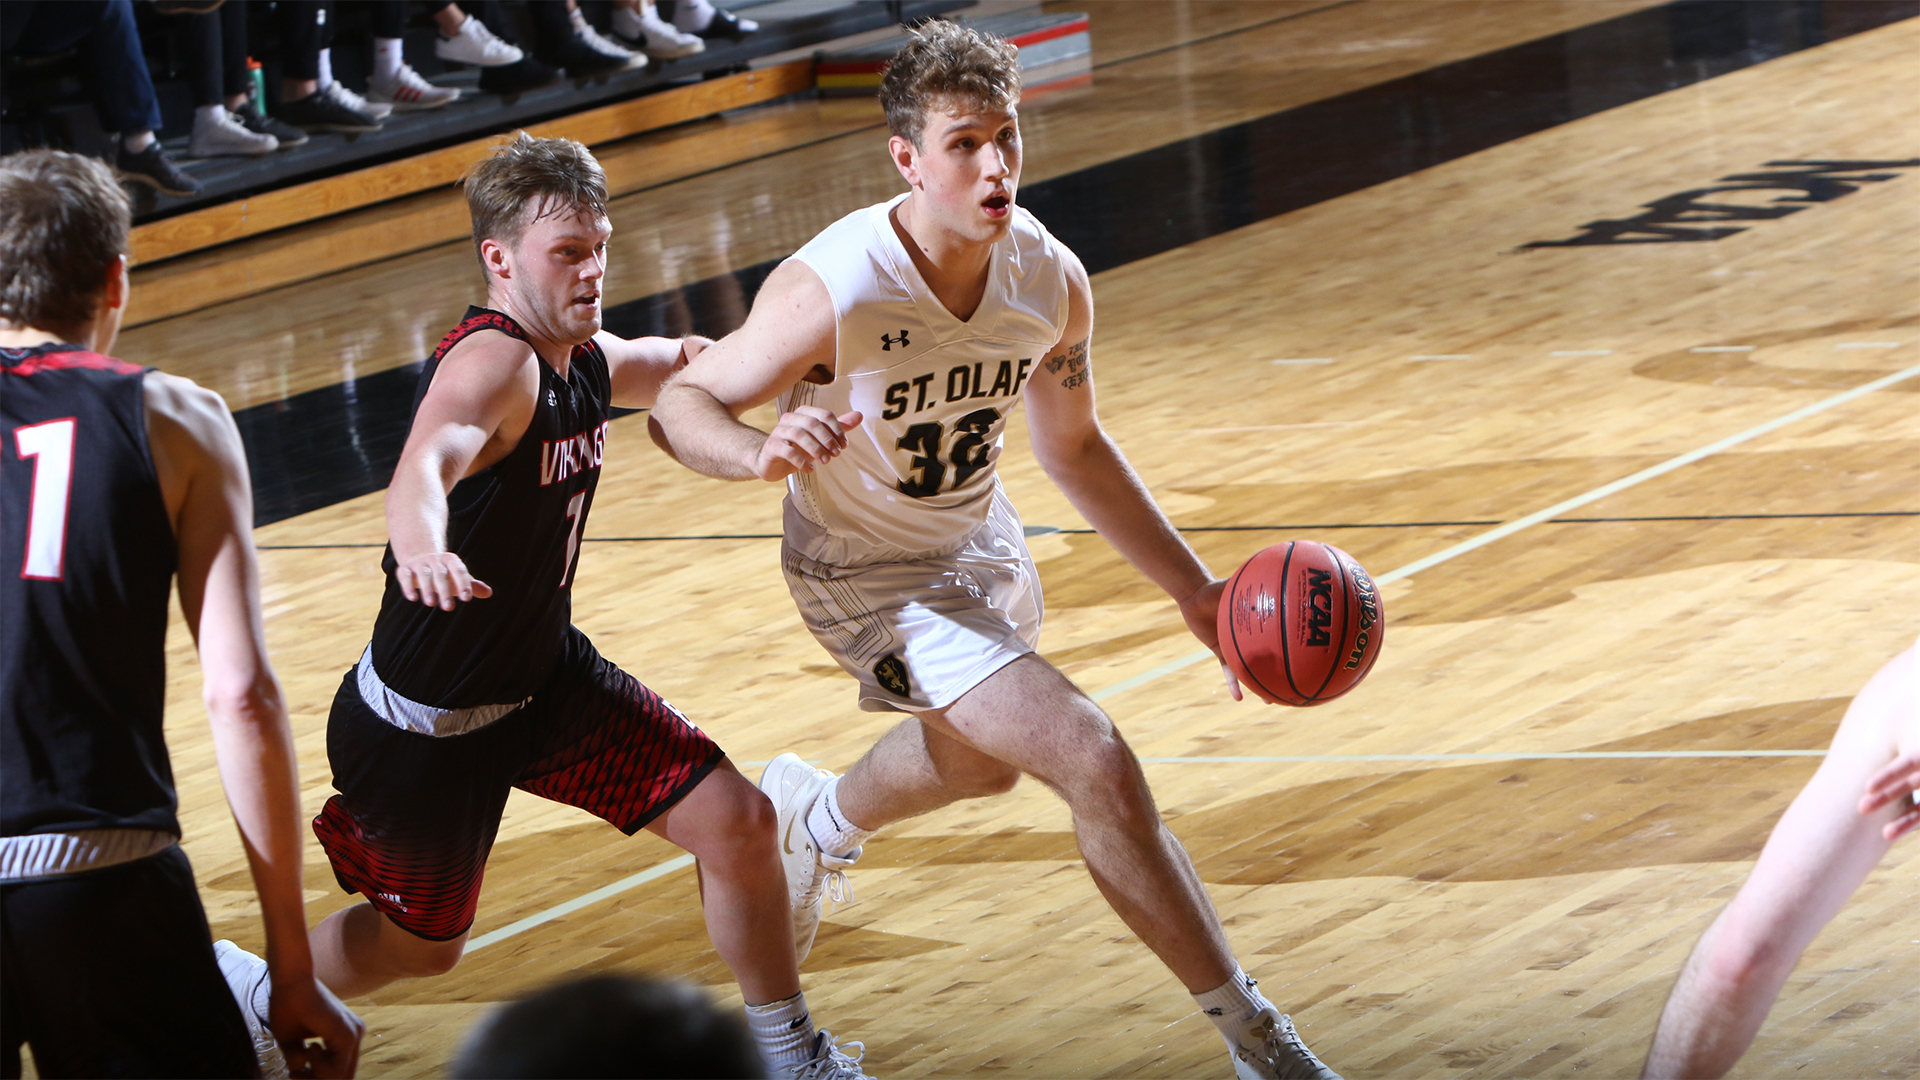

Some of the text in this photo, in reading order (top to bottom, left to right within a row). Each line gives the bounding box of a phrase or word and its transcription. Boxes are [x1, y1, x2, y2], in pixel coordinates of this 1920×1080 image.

[1514, 157, 1920, 249] NCAA
[882, 357, 1033, 421] ST. OLAF
[895, 407, 1002, 498] 32
[1307, 567, 1332, 648] NCAA
[1343, 562, 1378, 671] Wilson
